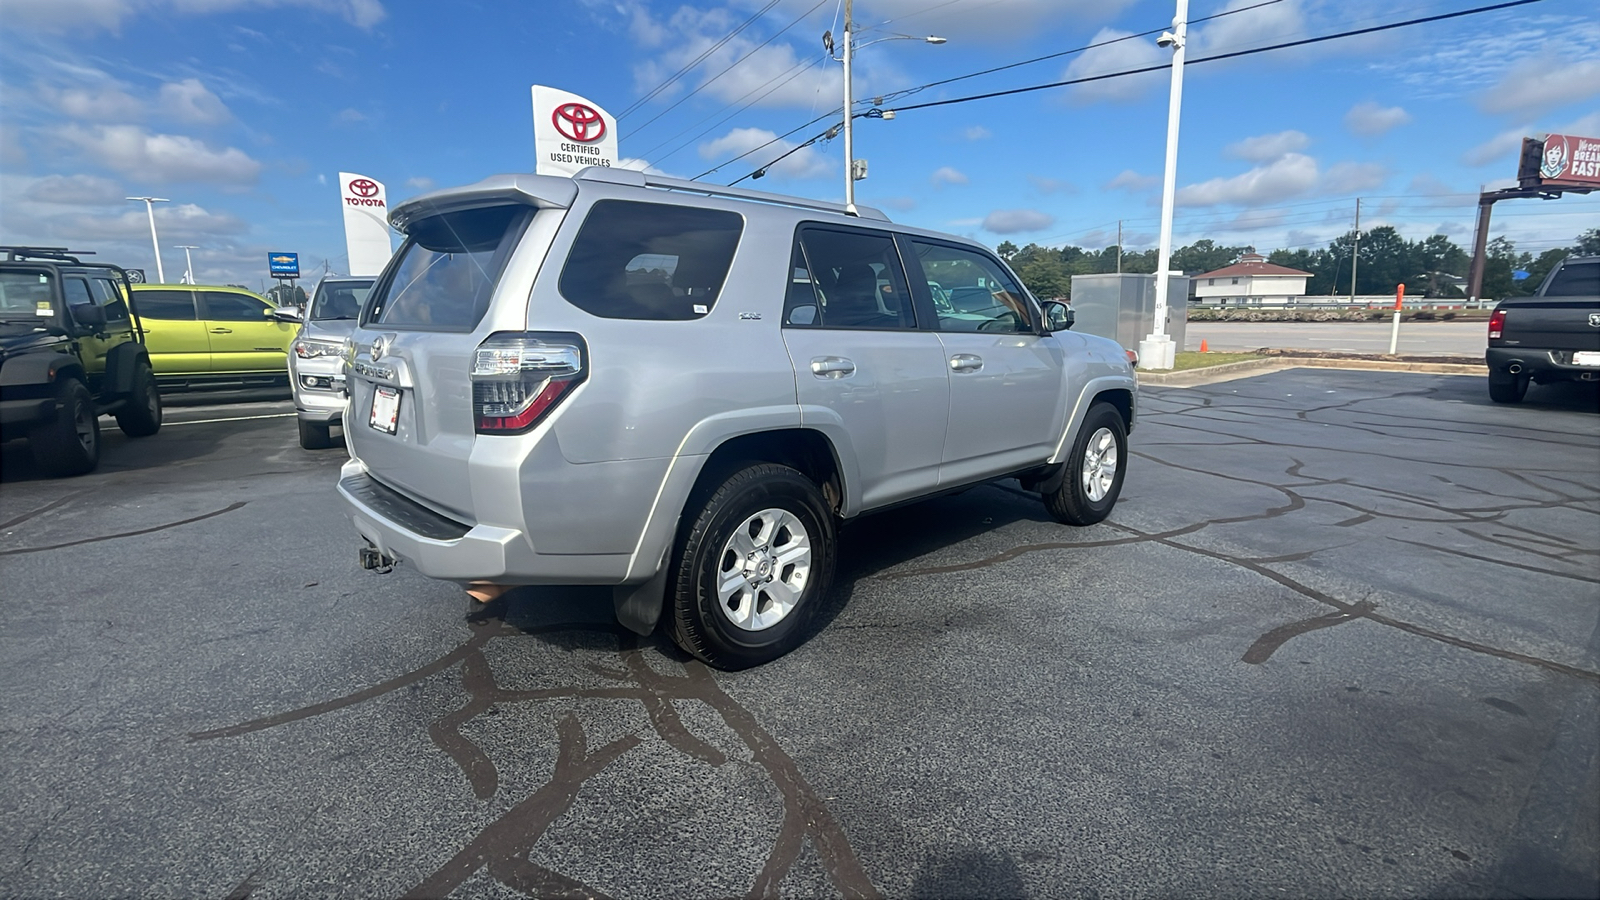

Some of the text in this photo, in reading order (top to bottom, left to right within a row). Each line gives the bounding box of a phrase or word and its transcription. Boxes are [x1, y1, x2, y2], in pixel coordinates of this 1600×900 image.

[560, 143, 600, 155] CERTIFIED
[550, 153, 611, 167] USED VEHICLES
[345, 197, 385, 207] TOYOTA
